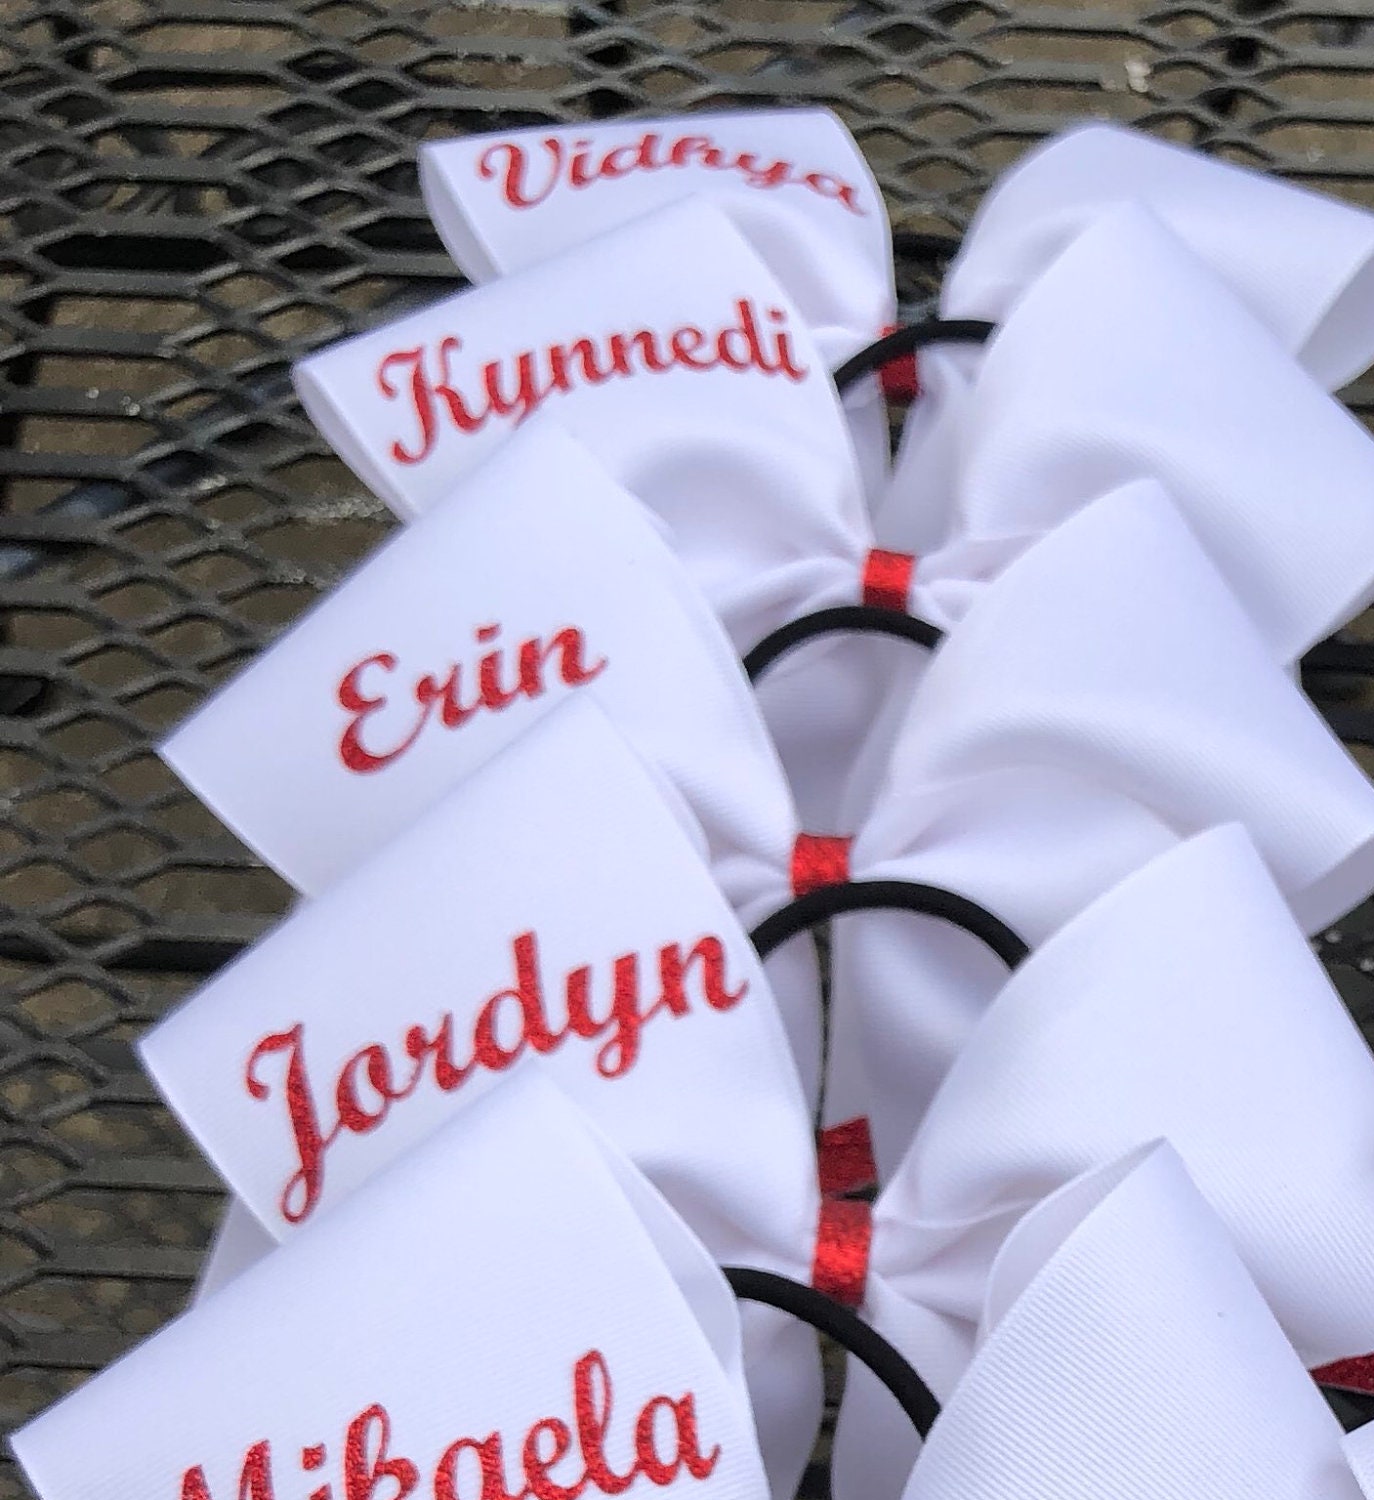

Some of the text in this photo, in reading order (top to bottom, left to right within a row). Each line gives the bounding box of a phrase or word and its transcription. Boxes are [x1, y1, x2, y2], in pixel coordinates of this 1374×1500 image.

[478, 131, 868, 216] Vidhya
[376, 295, 808, 465] Kynnedi
[337, 624, 606, 774] Erin
[244, 930, 747, 1223] Jordyn
